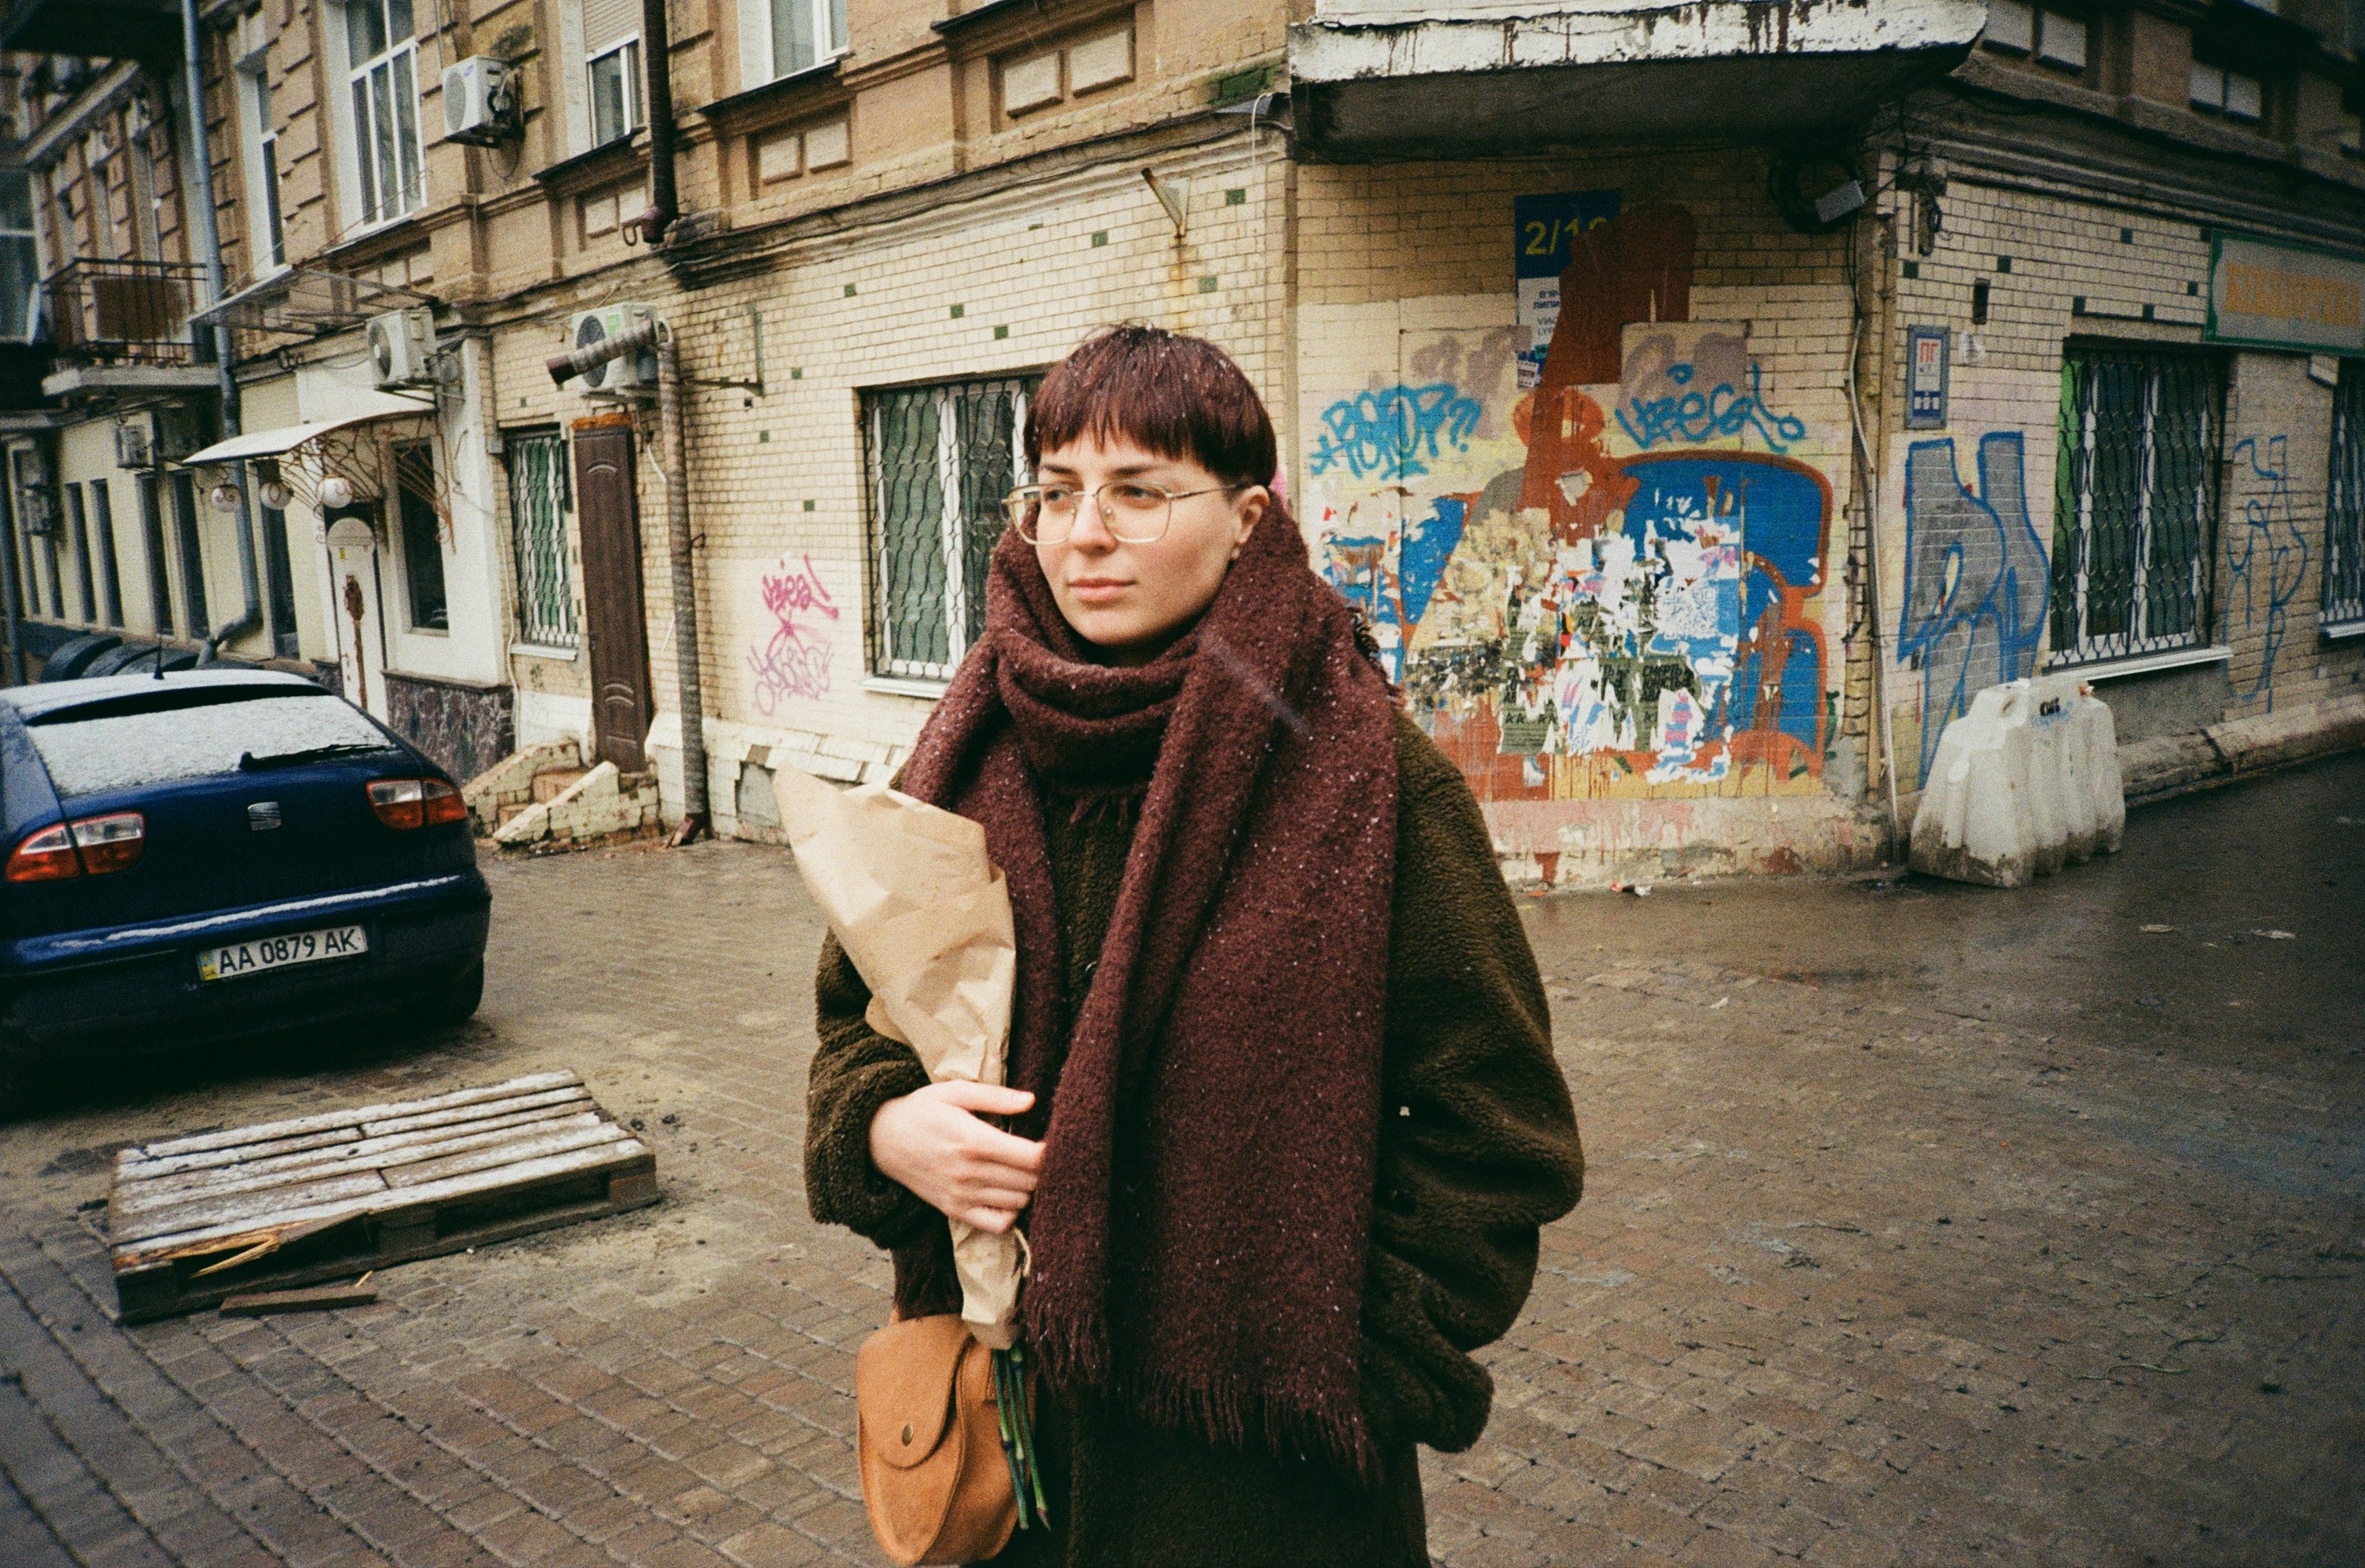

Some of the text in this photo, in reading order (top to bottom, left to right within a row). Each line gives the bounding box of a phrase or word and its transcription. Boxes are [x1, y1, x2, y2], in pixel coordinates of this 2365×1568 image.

[1525, 216, 1608, 255] 2/1
[219, 928, 359, 974] AA 0879 AK
